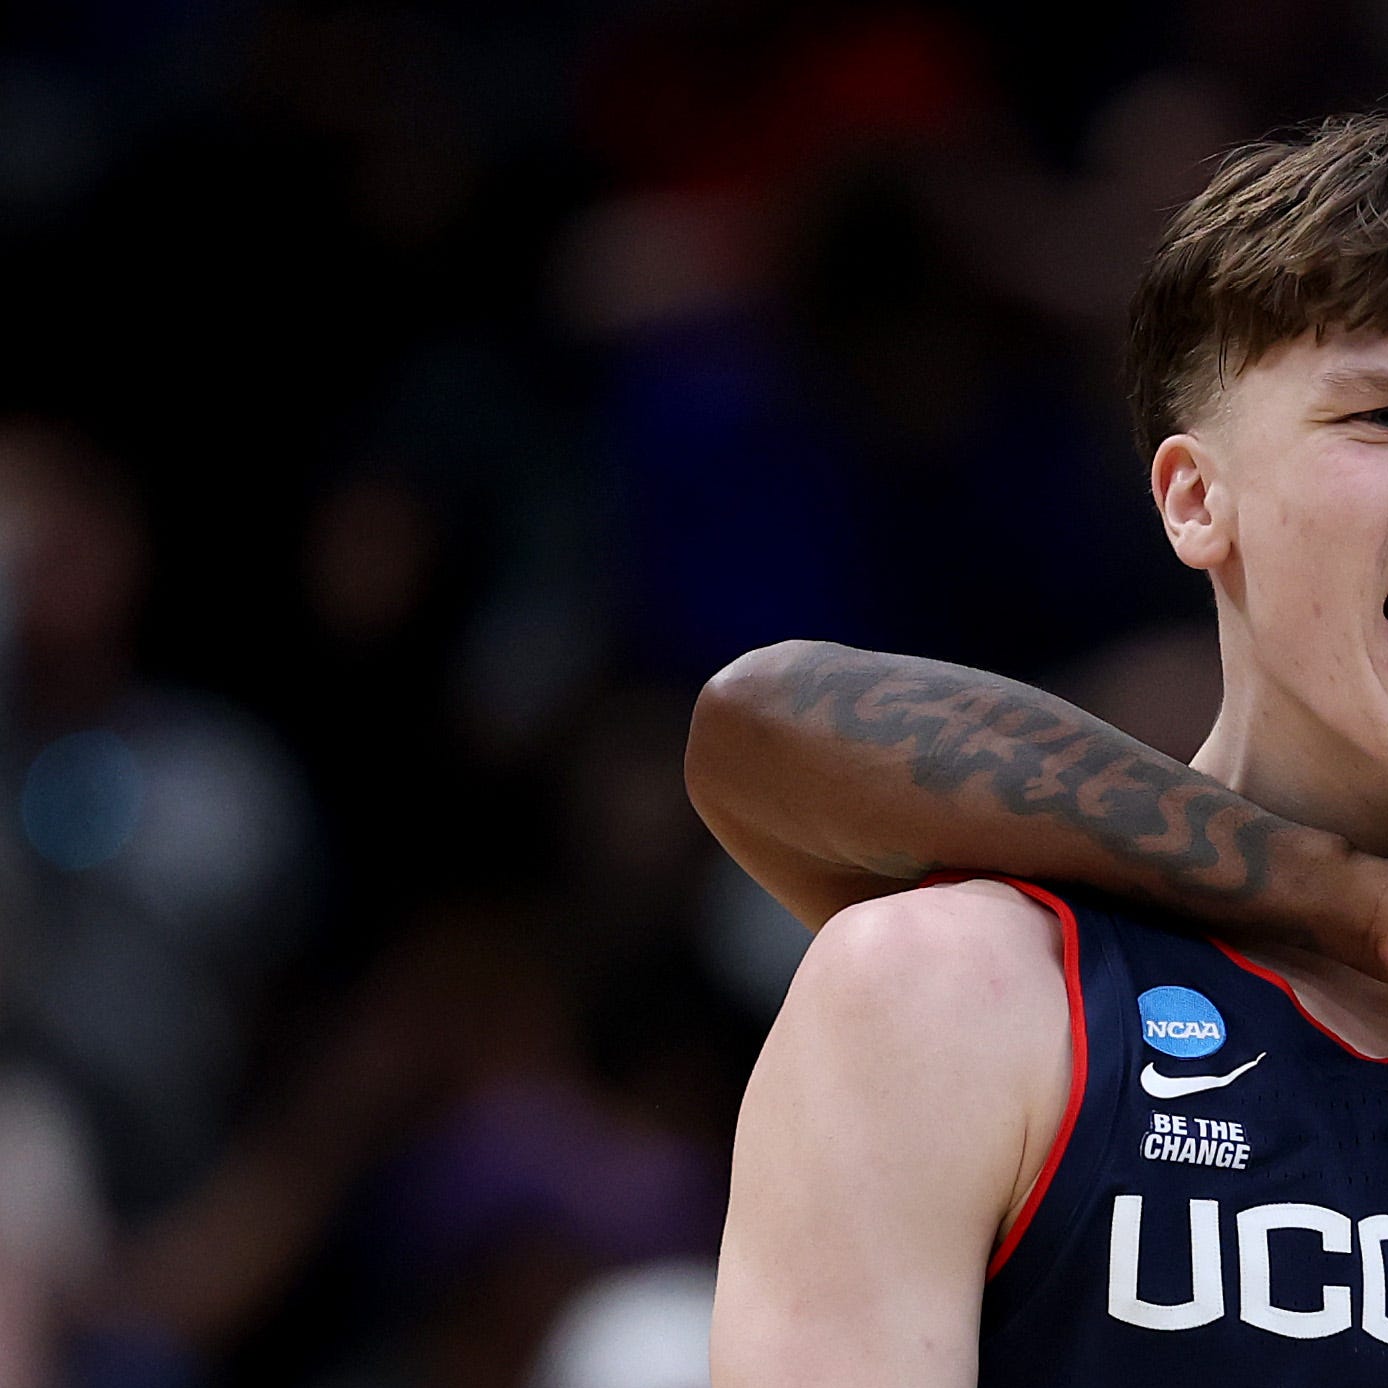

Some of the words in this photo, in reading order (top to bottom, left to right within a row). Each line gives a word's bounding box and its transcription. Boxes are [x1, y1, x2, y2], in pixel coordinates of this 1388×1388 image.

[1146, 1019, 1221, 1040] NCAA
[1153, 1113, 1188, 1135] BE
[1194, 1118, 1244, 1142] THE
[1143, 1133, 1251, 1170] CHANGE
